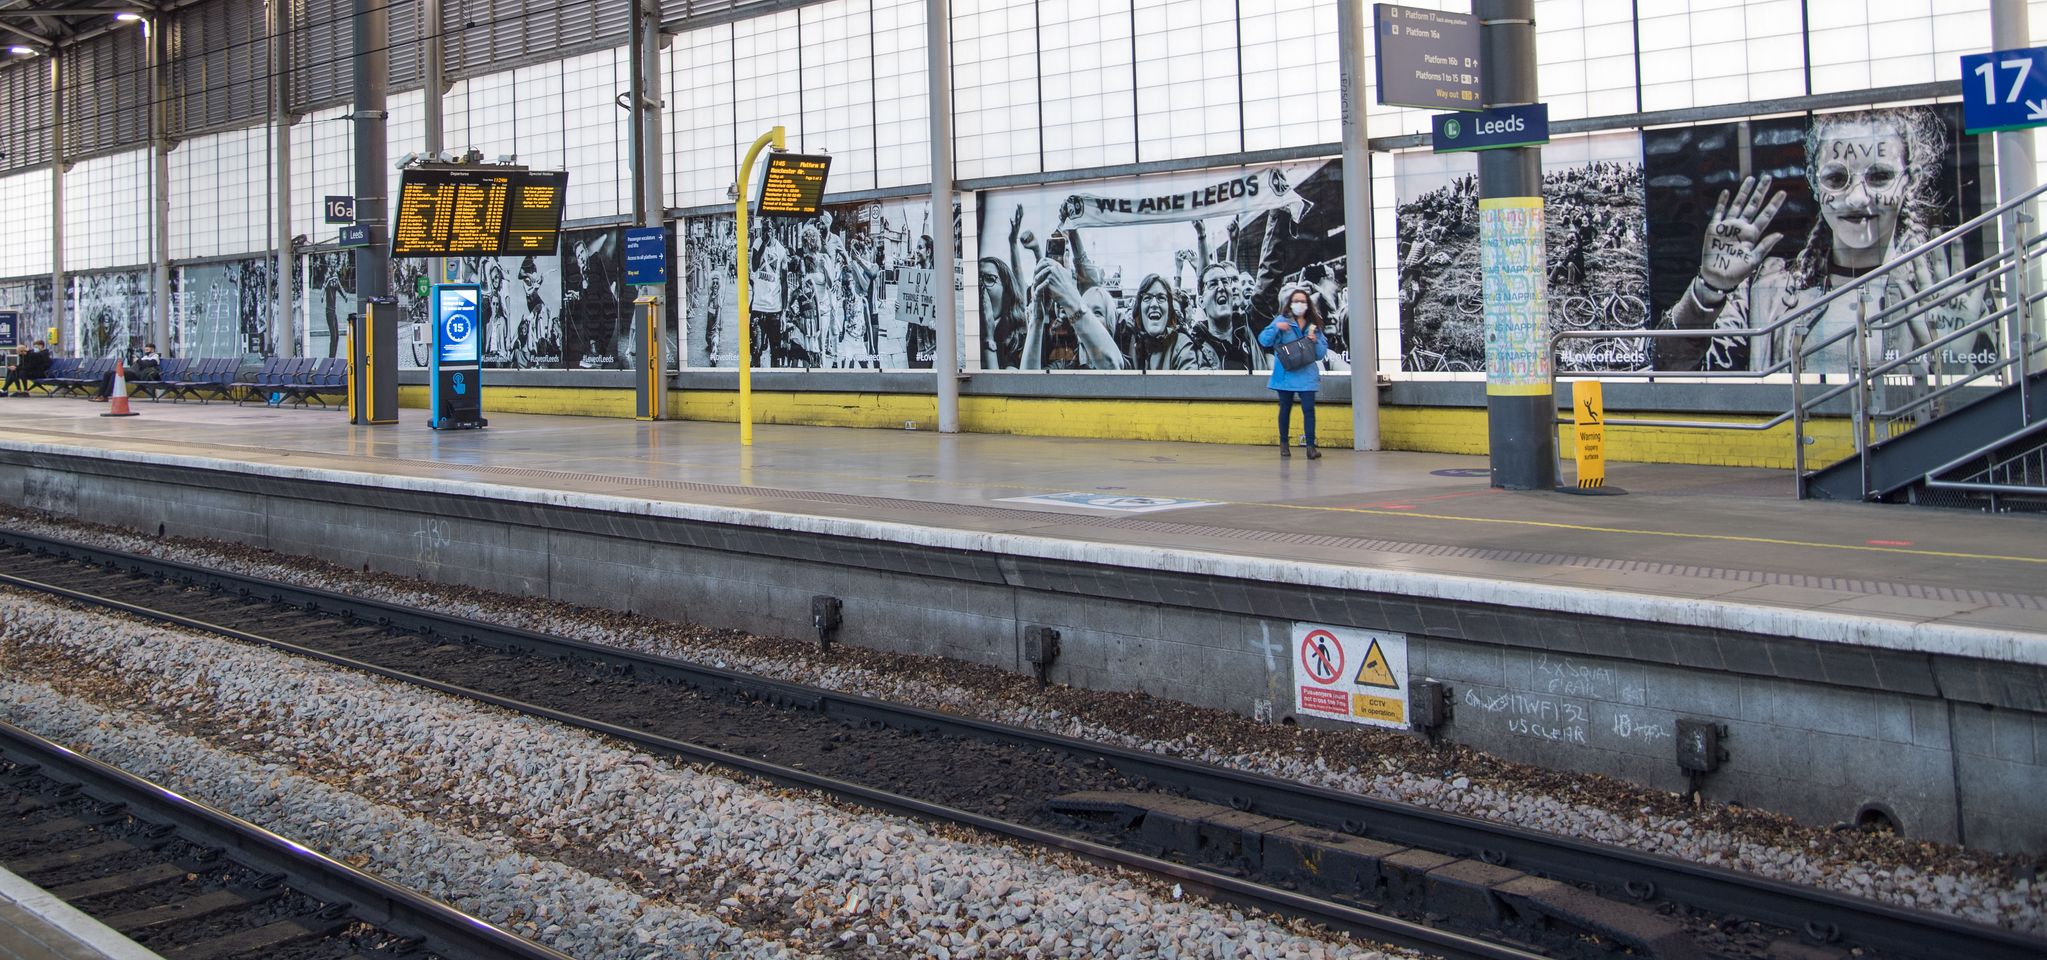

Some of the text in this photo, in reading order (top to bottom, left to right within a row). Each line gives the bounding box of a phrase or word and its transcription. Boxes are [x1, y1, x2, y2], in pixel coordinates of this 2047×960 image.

[1405, 10, 1429, 21] Platform
[1429, 13, 1436, 22] 17
[1405, 27, 1441, 39] Platform 16a
[1424, 54, 1459, 66] Platform 16b
[1415, 70, 1442, 81] Platforms
[1452, 74, 1459, 83] 15
[1974, 57, 2033, 105] 17
[1436, 88, 1460, 99] Way out
[1475, 114, 1525, 136] Leeds
[1832, 141, 1888, 161] SAVE
[1097, 175, 1259, 214] WE ARE LEEDS
[327, 201, 353, 217] 16a
[350, 229, 364, 240] Leeds
[1715, 223, 1742, 242] OUR
[1711, 239, 1751, 263] FUTURE
[1714, 255, 1730, 271] IN
[908, 271, 931, 285] LOV
[922, 285, 928, 294] A
[905, 301, 936, 319] HATE
[452, 323, 464, 333] 15
[582, 354, 614, 363] #LoveofLeeds
[1560, 349, 1645, 366] #LoveofLeeds
[1579, 432, 1601, 442] Warning
[1369, 699, 1386, 707] CCTV
[1368, 708, 1396, 717] operation
